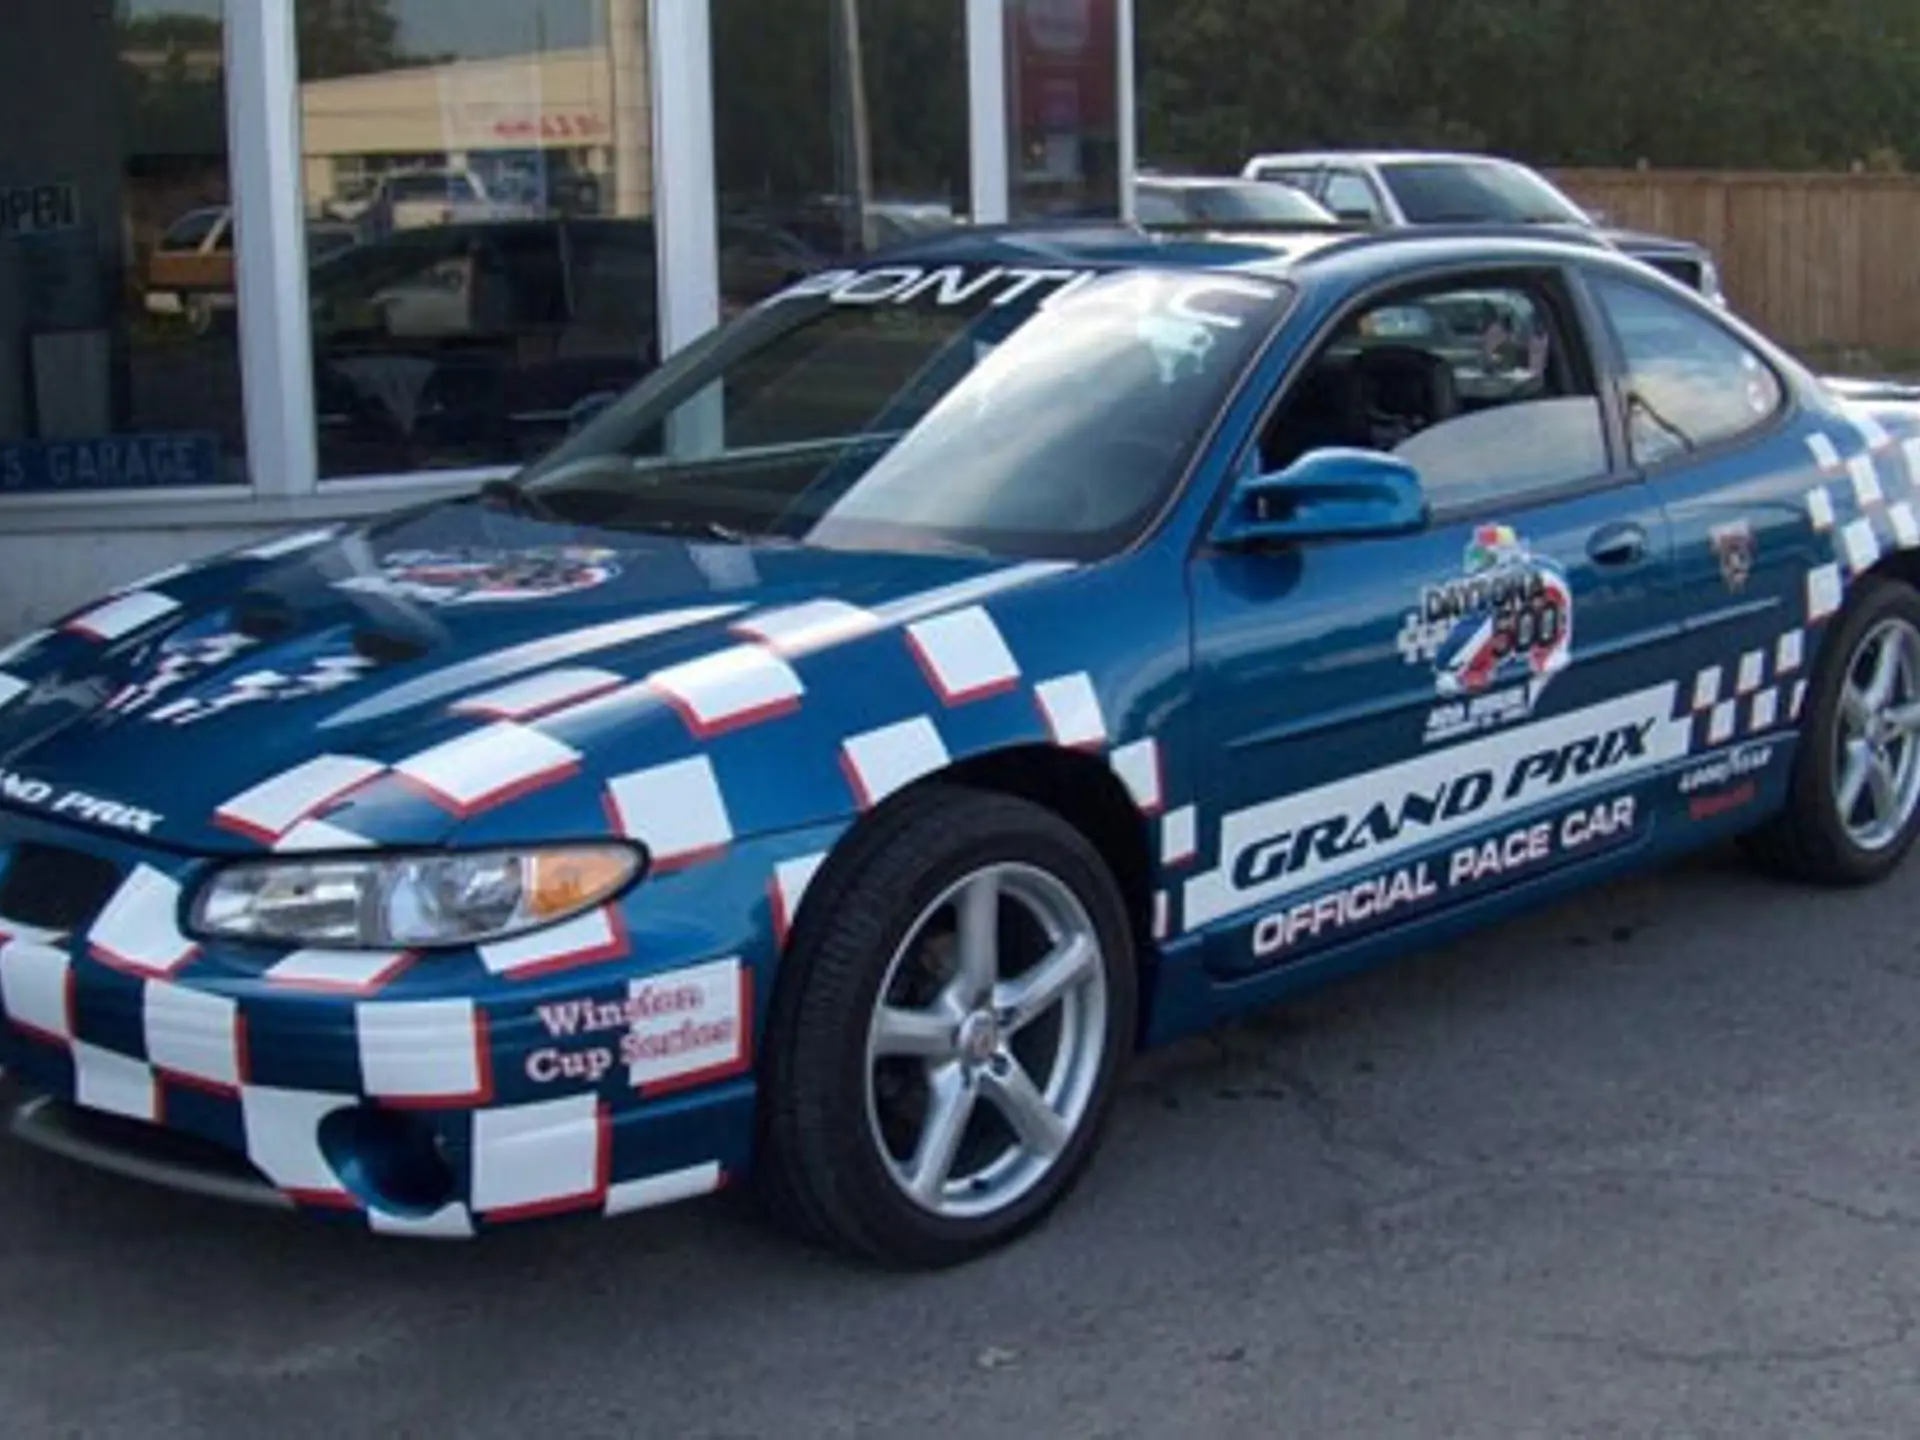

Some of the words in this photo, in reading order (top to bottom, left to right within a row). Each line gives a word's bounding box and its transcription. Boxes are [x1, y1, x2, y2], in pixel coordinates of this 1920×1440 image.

[49, 441, 197, 486] GARAGE
[1426, 572, 1547, 624] DAYTONA
[1492, 602, 1559, 659] 500
[51, 790, 165, 836] PRIX
[1233, 769, 1493, 890] GRAND
[1505, 716, 1656, 798] PRIX
[1252, 861, 1438, 957] OFFICIAL
[1449, 823, 1550, 888] PACE
[1560, 796, 1636, 849] CAR
[538, 984, 704, 1037] Winston
[525, 1047, 612, 1083] Cup
